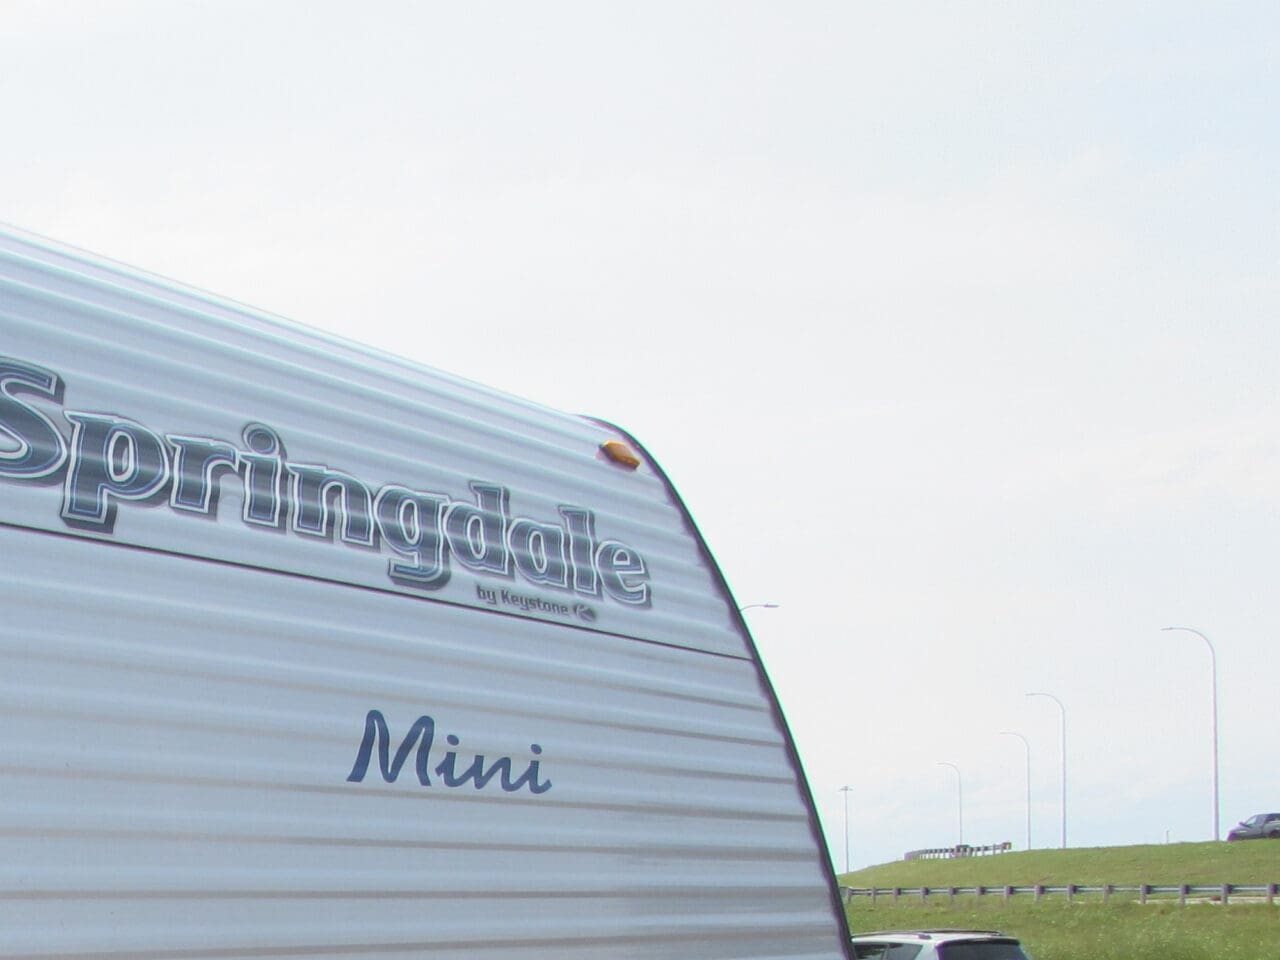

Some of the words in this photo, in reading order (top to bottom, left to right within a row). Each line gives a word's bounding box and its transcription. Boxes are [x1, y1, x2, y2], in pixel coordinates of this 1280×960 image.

[476, 584, 497, 605] by
[501, 589, 570, 616] Keystone
[346, 709, 553, 794] Mini
